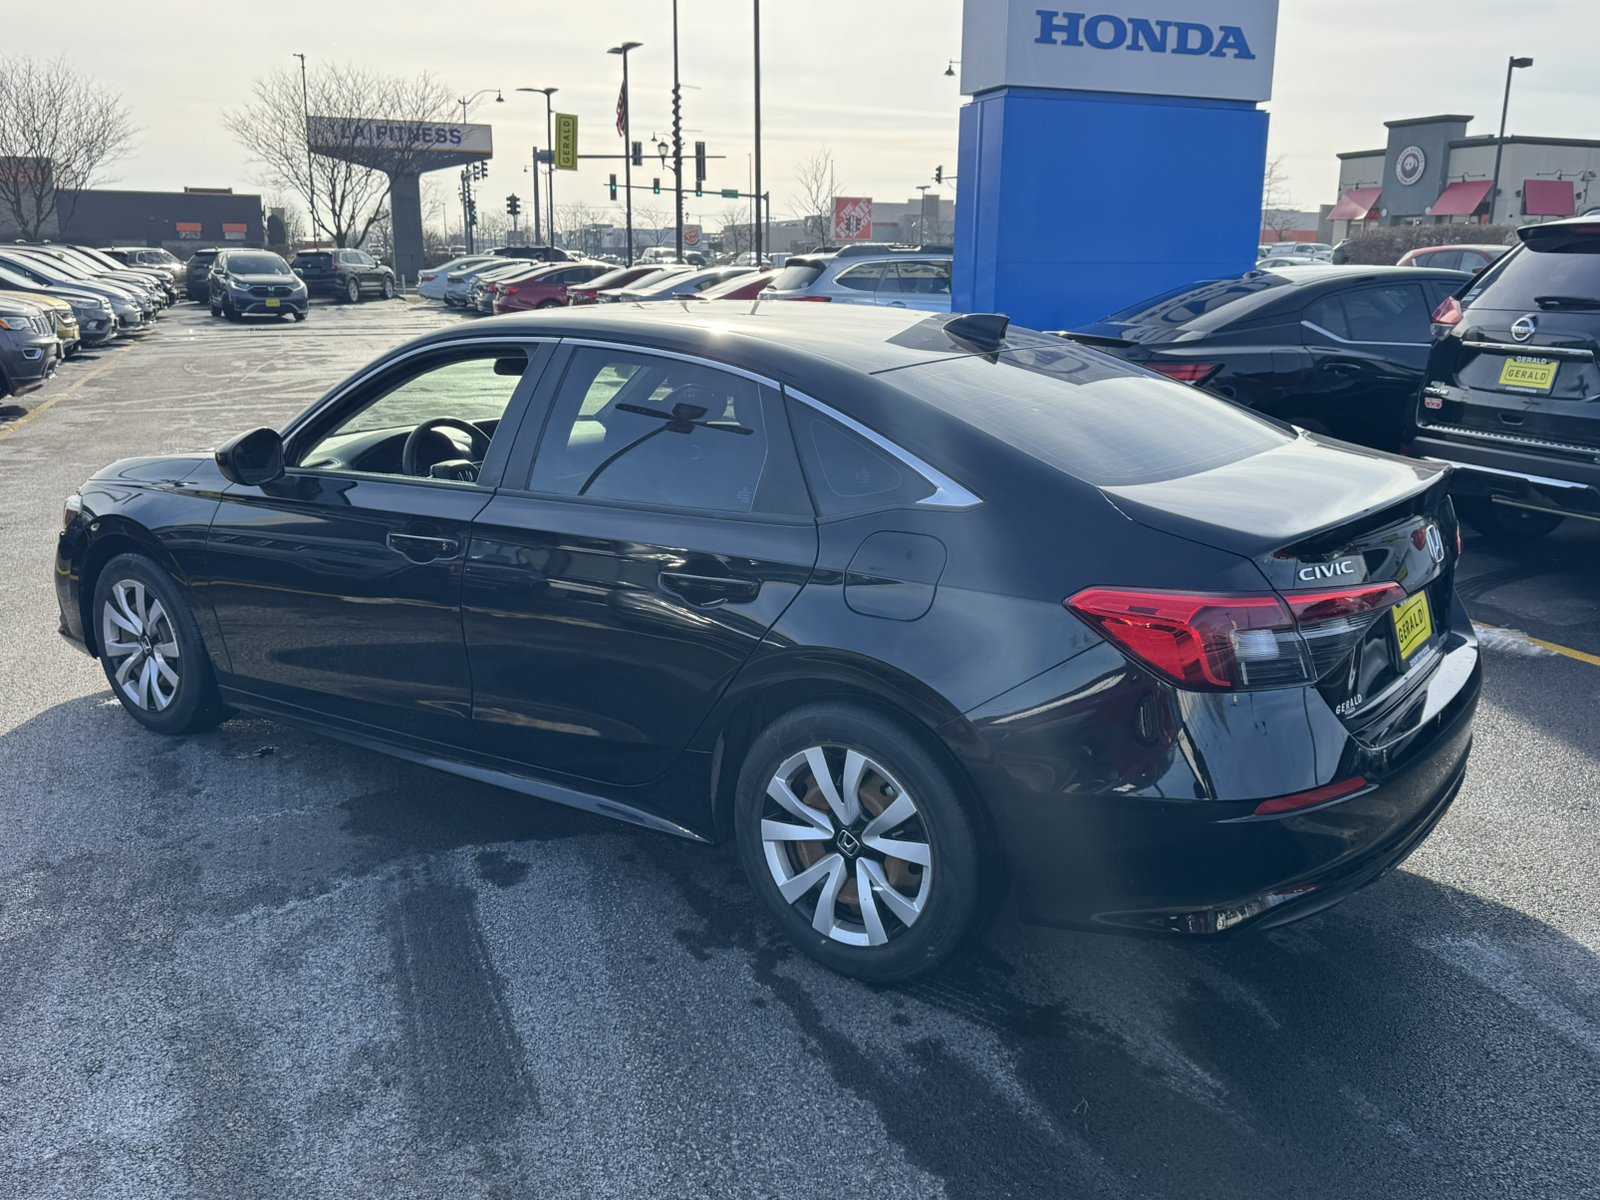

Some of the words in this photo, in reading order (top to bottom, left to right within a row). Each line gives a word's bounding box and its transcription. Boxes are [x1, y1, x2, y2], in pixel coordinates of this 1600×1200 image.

[1034, 9, 1256, 60] HONDA
[562, 120, 571, 164] GERALD
[1515, 356, 1547, 365] GERALD
[1507, 369, 1547, 381] GERALD
[1299, 560, 1354, 581] CIVIC
[1398, 608, 1424, 644] GERALD
[1335, 693, 1363, 715] GERALD
